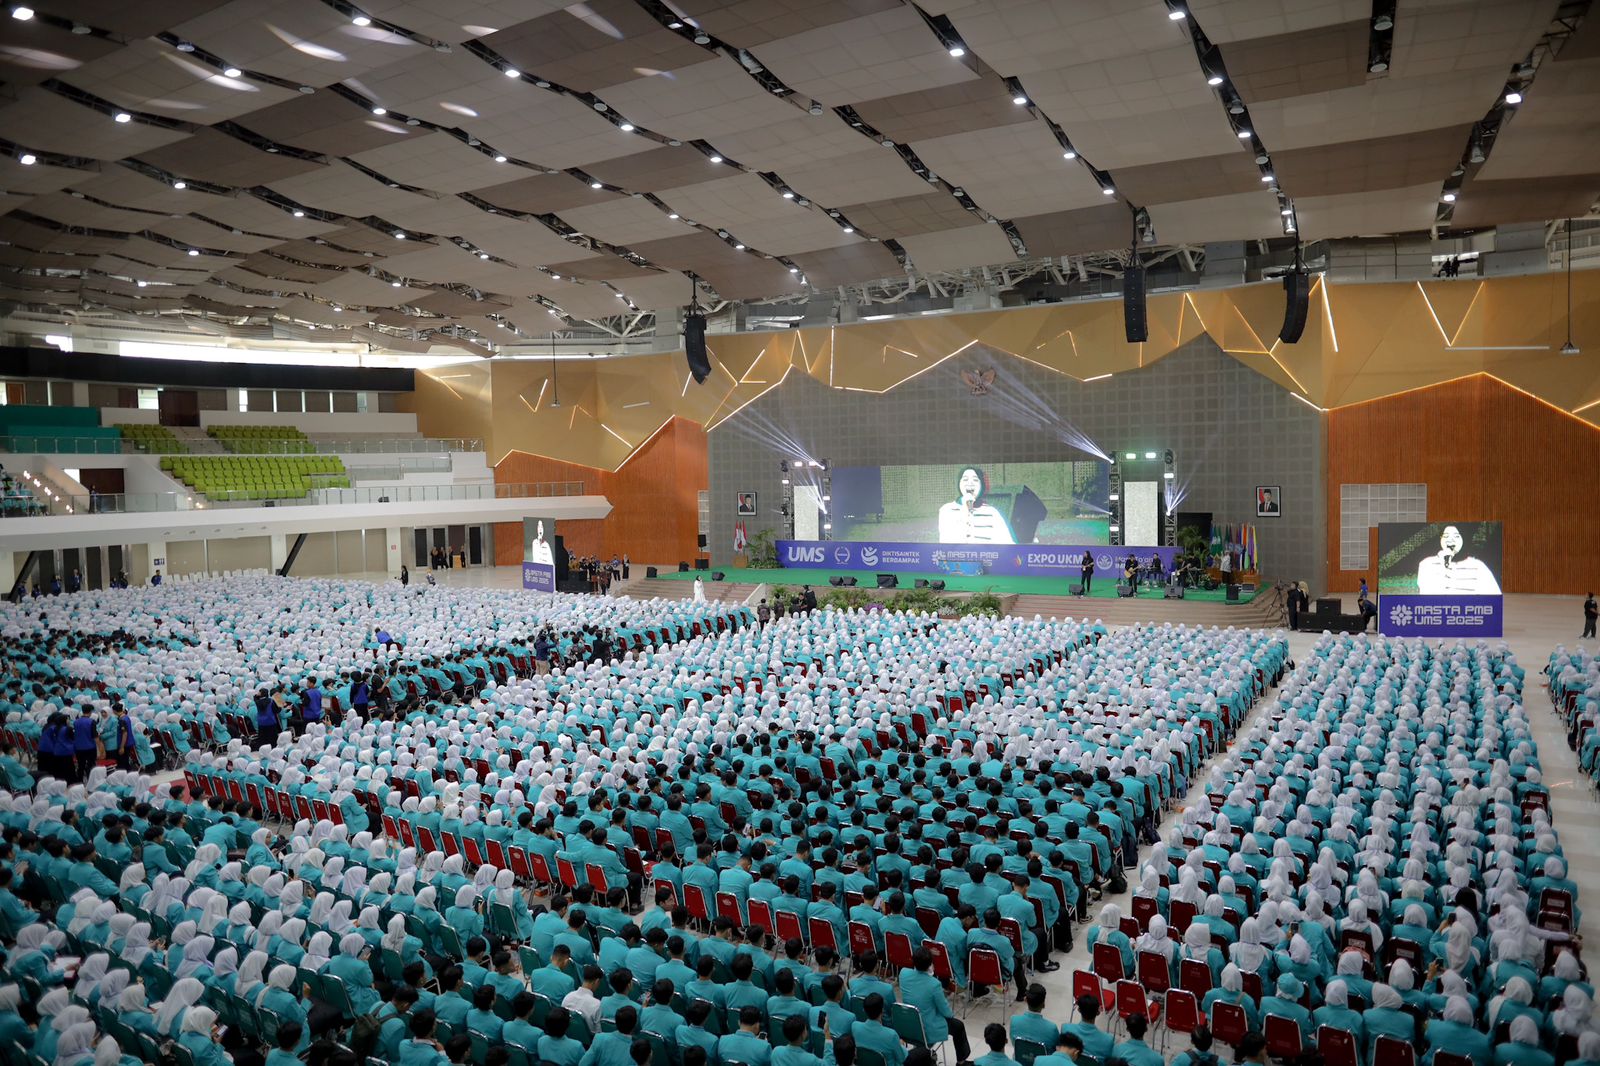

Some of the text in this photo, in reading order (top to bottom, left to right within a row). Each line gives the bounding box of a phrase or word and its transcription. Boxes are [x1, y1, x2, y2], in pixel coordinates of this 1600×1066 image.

[788, 546, 825, 563] UMS
[980, 551, 999, 559] PMB
[1028, 553, 1084, 565] EXPO UKM
[1414, 605, 1493, 615] MASTA PMB
[1414, 616, 1484, 625] UMS 2025
